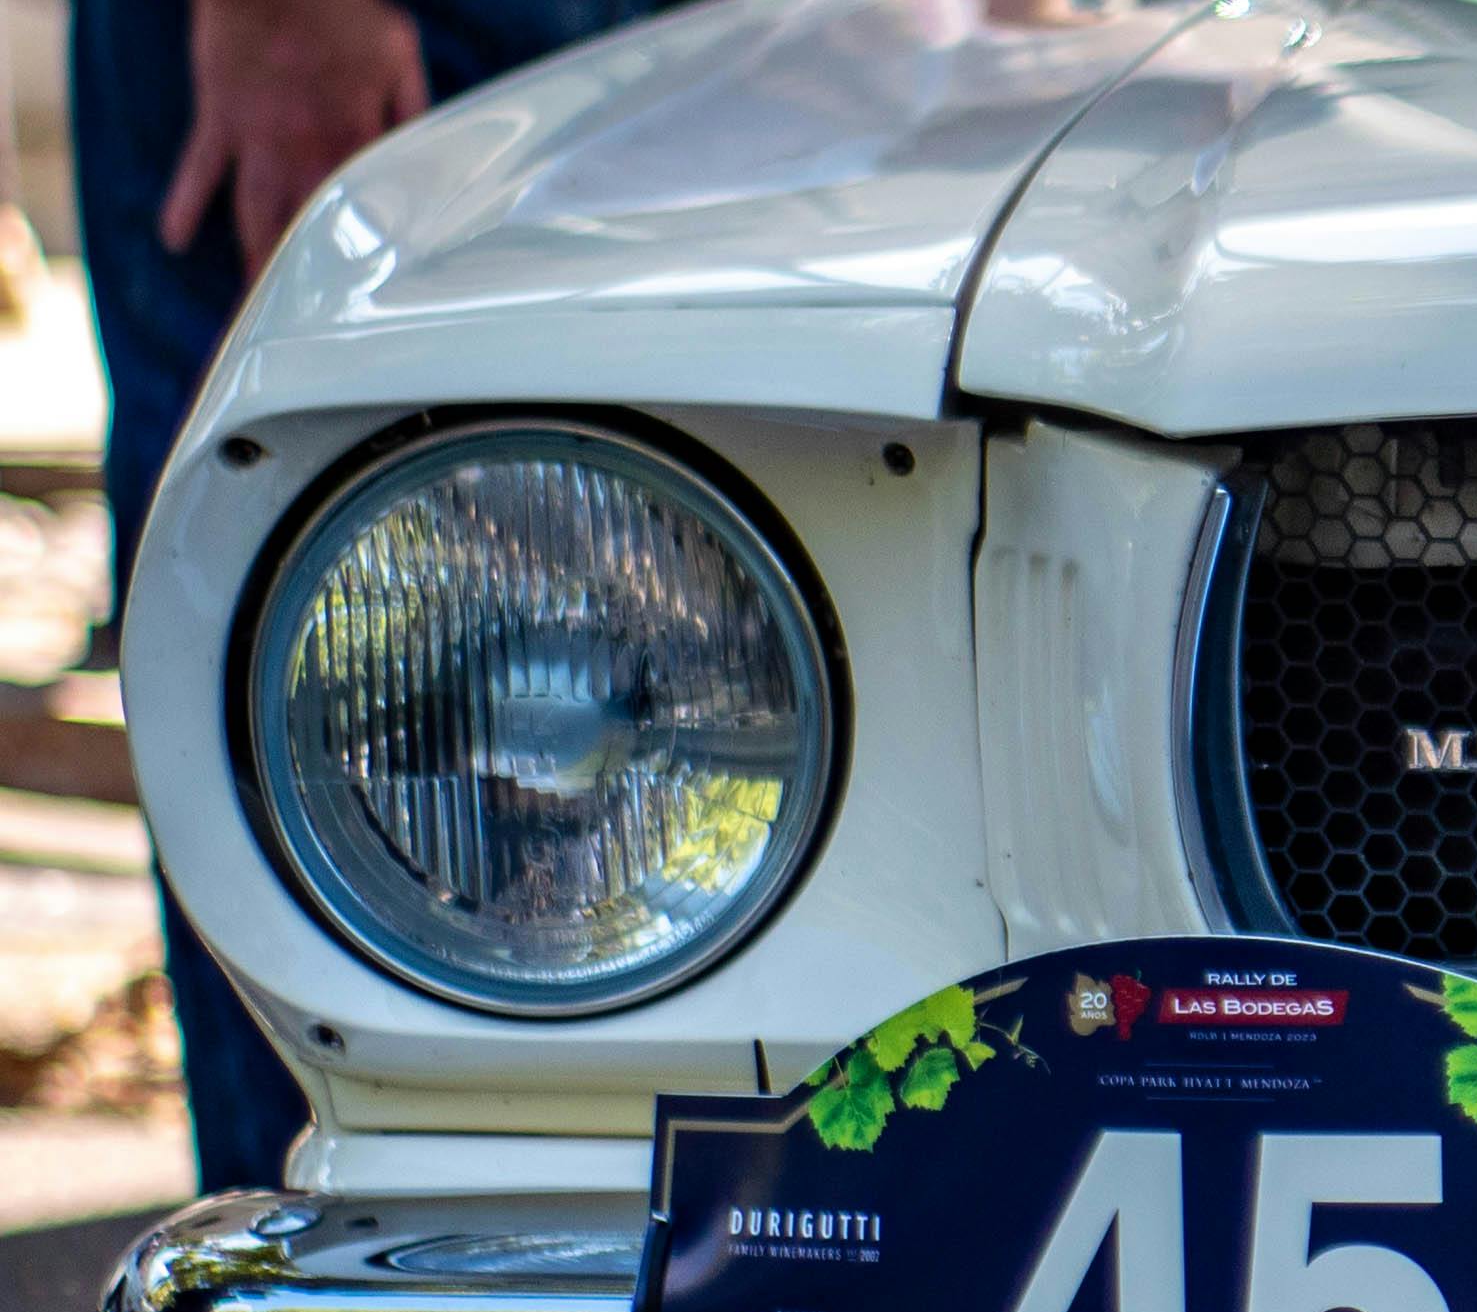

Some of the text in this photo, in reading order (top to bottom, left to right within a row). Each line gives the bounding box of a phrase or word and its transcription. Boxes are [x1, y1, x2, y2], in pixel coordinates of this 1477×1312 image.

[1207, 972, 1298, 986] RALLY DE
[1080, 993, 1107, 1009] 20
[1173, 997, 1335, 1017] LAS BODEGAS
[1140, 1075, 1177, 1087] PARK
[1239, 1078, 1310, 1090] MENDOZA
[730, 1209, 881, 1242] DURIGUTTI
